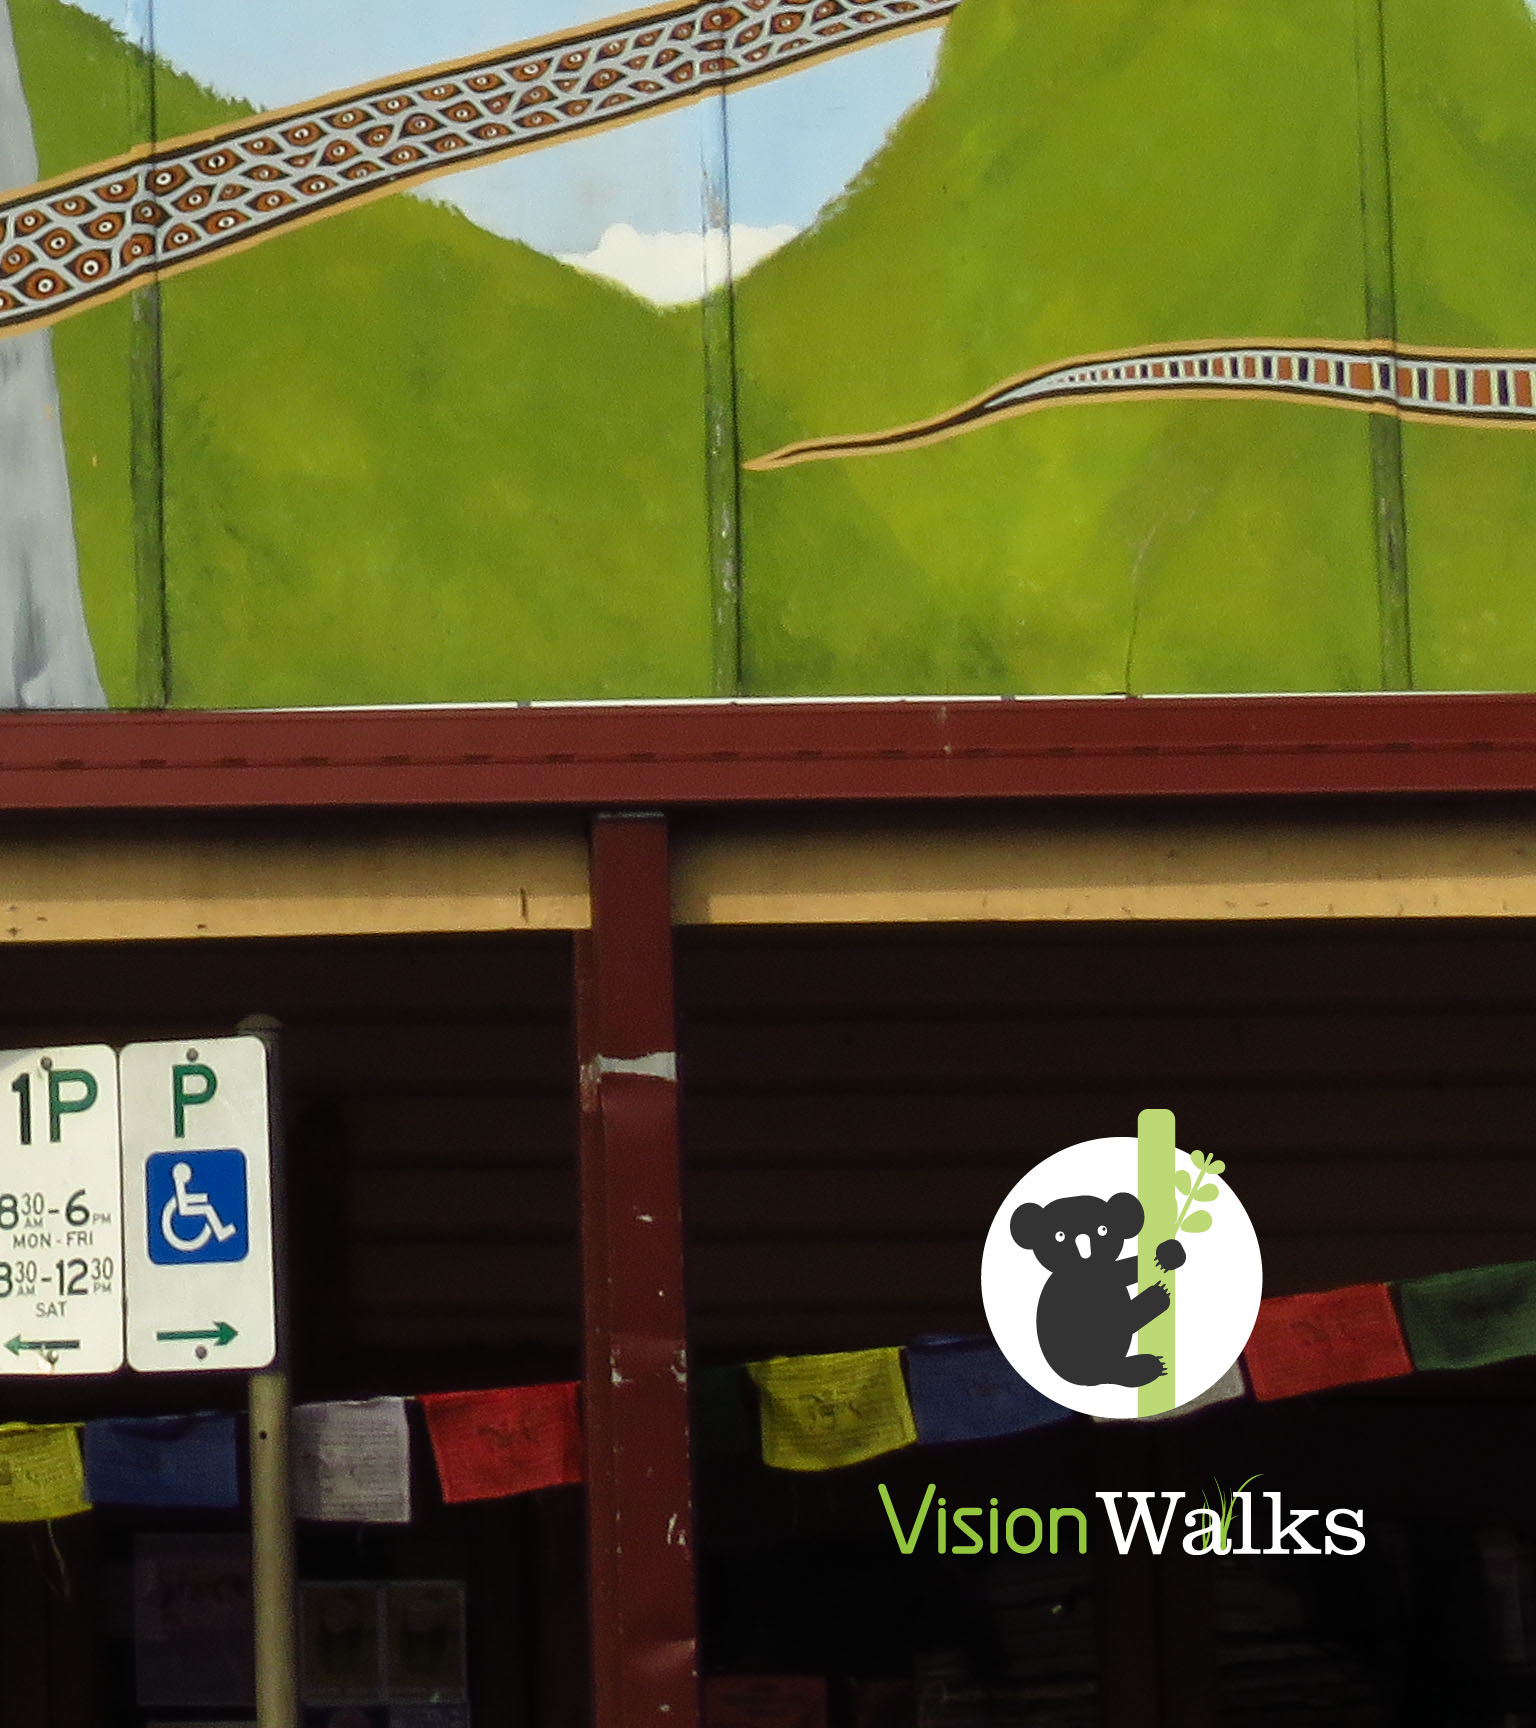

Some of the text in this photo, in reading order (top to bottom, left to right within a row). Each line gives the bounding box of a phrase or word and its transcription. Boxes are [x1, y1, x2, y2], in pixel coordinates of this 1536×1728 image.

[11, 1069, 99, 1145] 1P
[172, 1064, 219, 1138] P
[13, 1232, 52, 1249] MON
[66, 1230, 94, 1246] FRI
[35, 1301, 68, 1318] SAT
